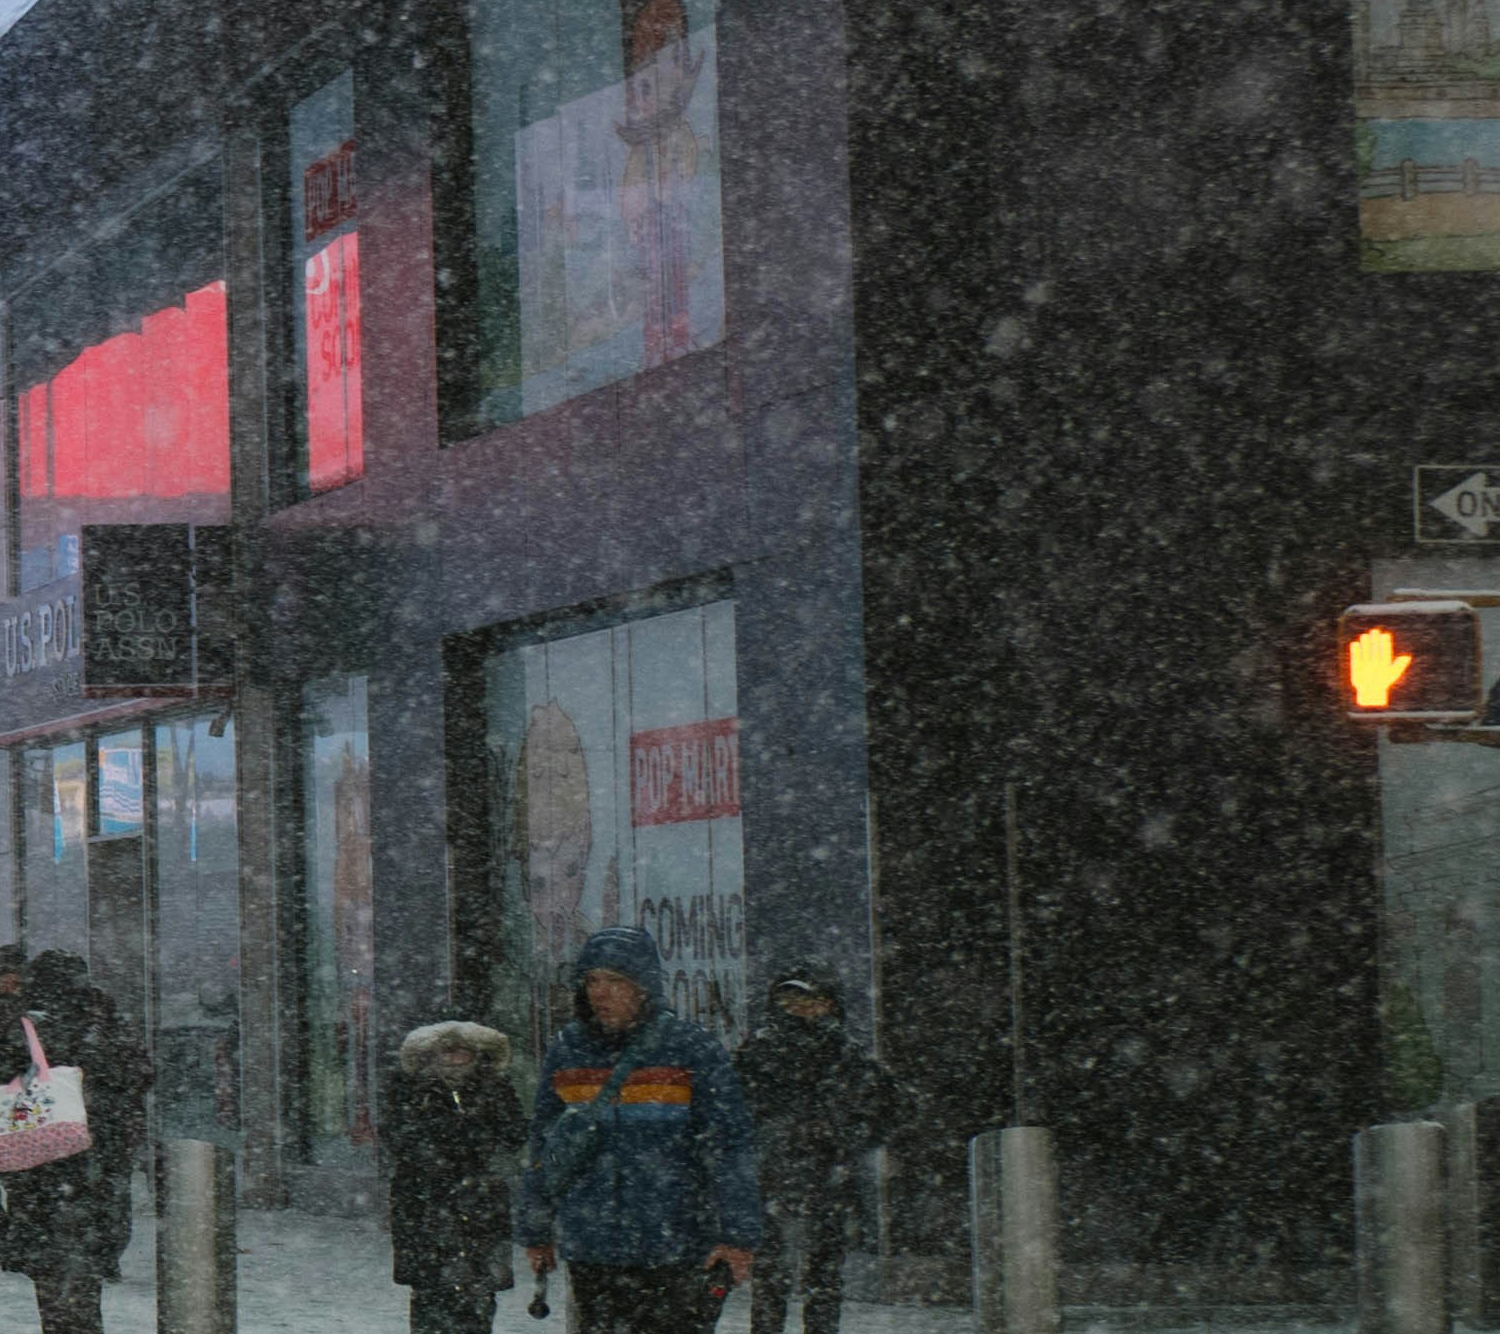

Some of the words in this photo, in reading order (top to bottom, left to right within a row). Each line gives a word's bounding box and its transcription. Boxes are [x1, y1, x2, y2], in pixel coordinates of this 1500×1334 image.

[1458, 490, 1500, 519] ON
[37, 594, 82, 668] POL
[93, 608, 179, 634] POLO
[634, 743, 674, 814] POP
